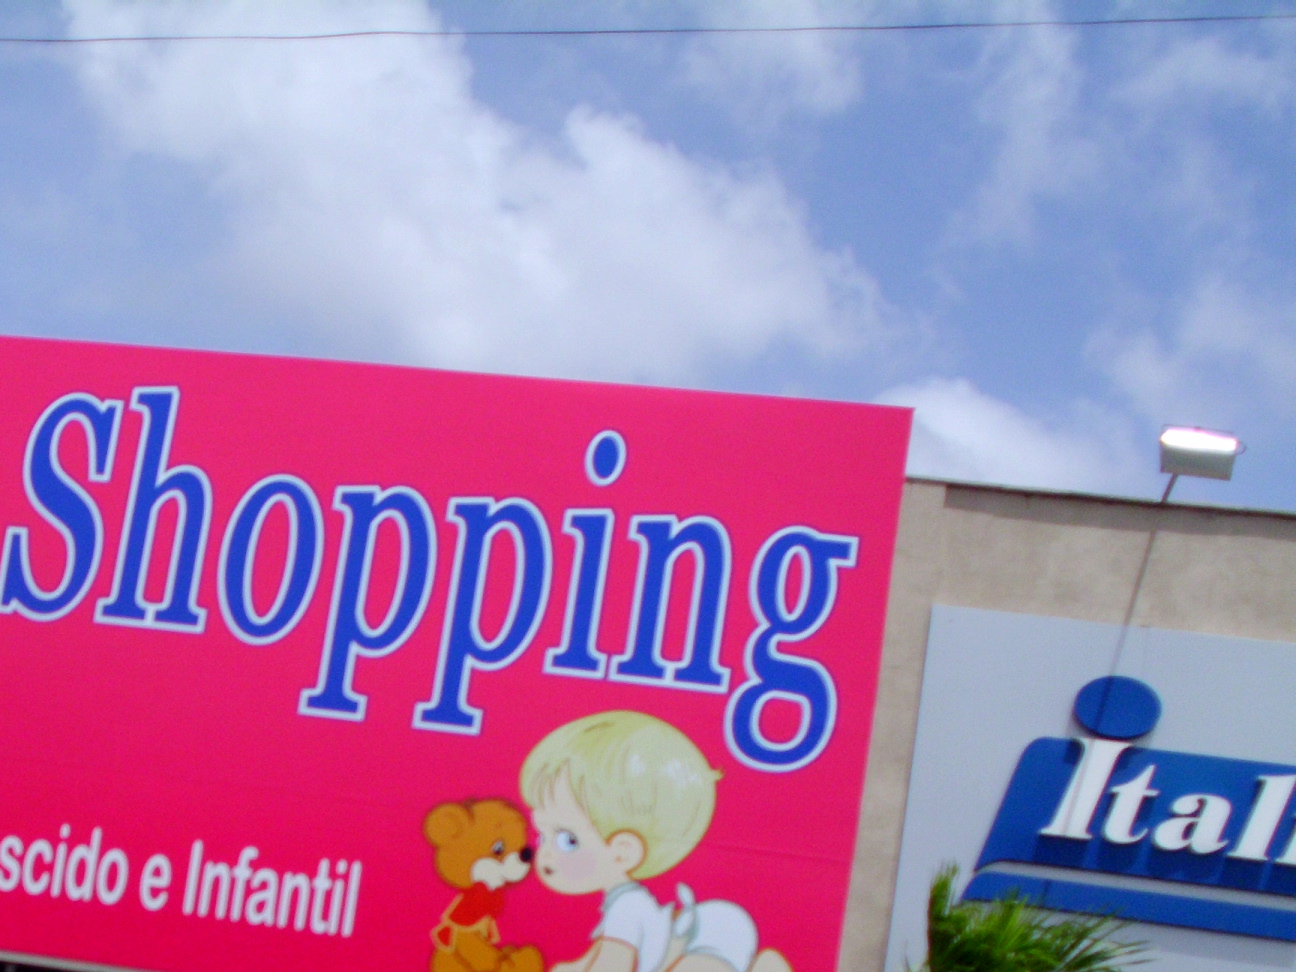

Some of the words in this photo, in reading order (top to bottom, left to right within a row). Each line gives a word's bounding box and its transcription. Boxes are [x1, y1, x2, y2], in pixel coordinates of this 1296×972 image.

[1037, 675, 1296, 867] Ital
[139, 853, 171, 911] e
[182, 839, 362, 937] Infantil
